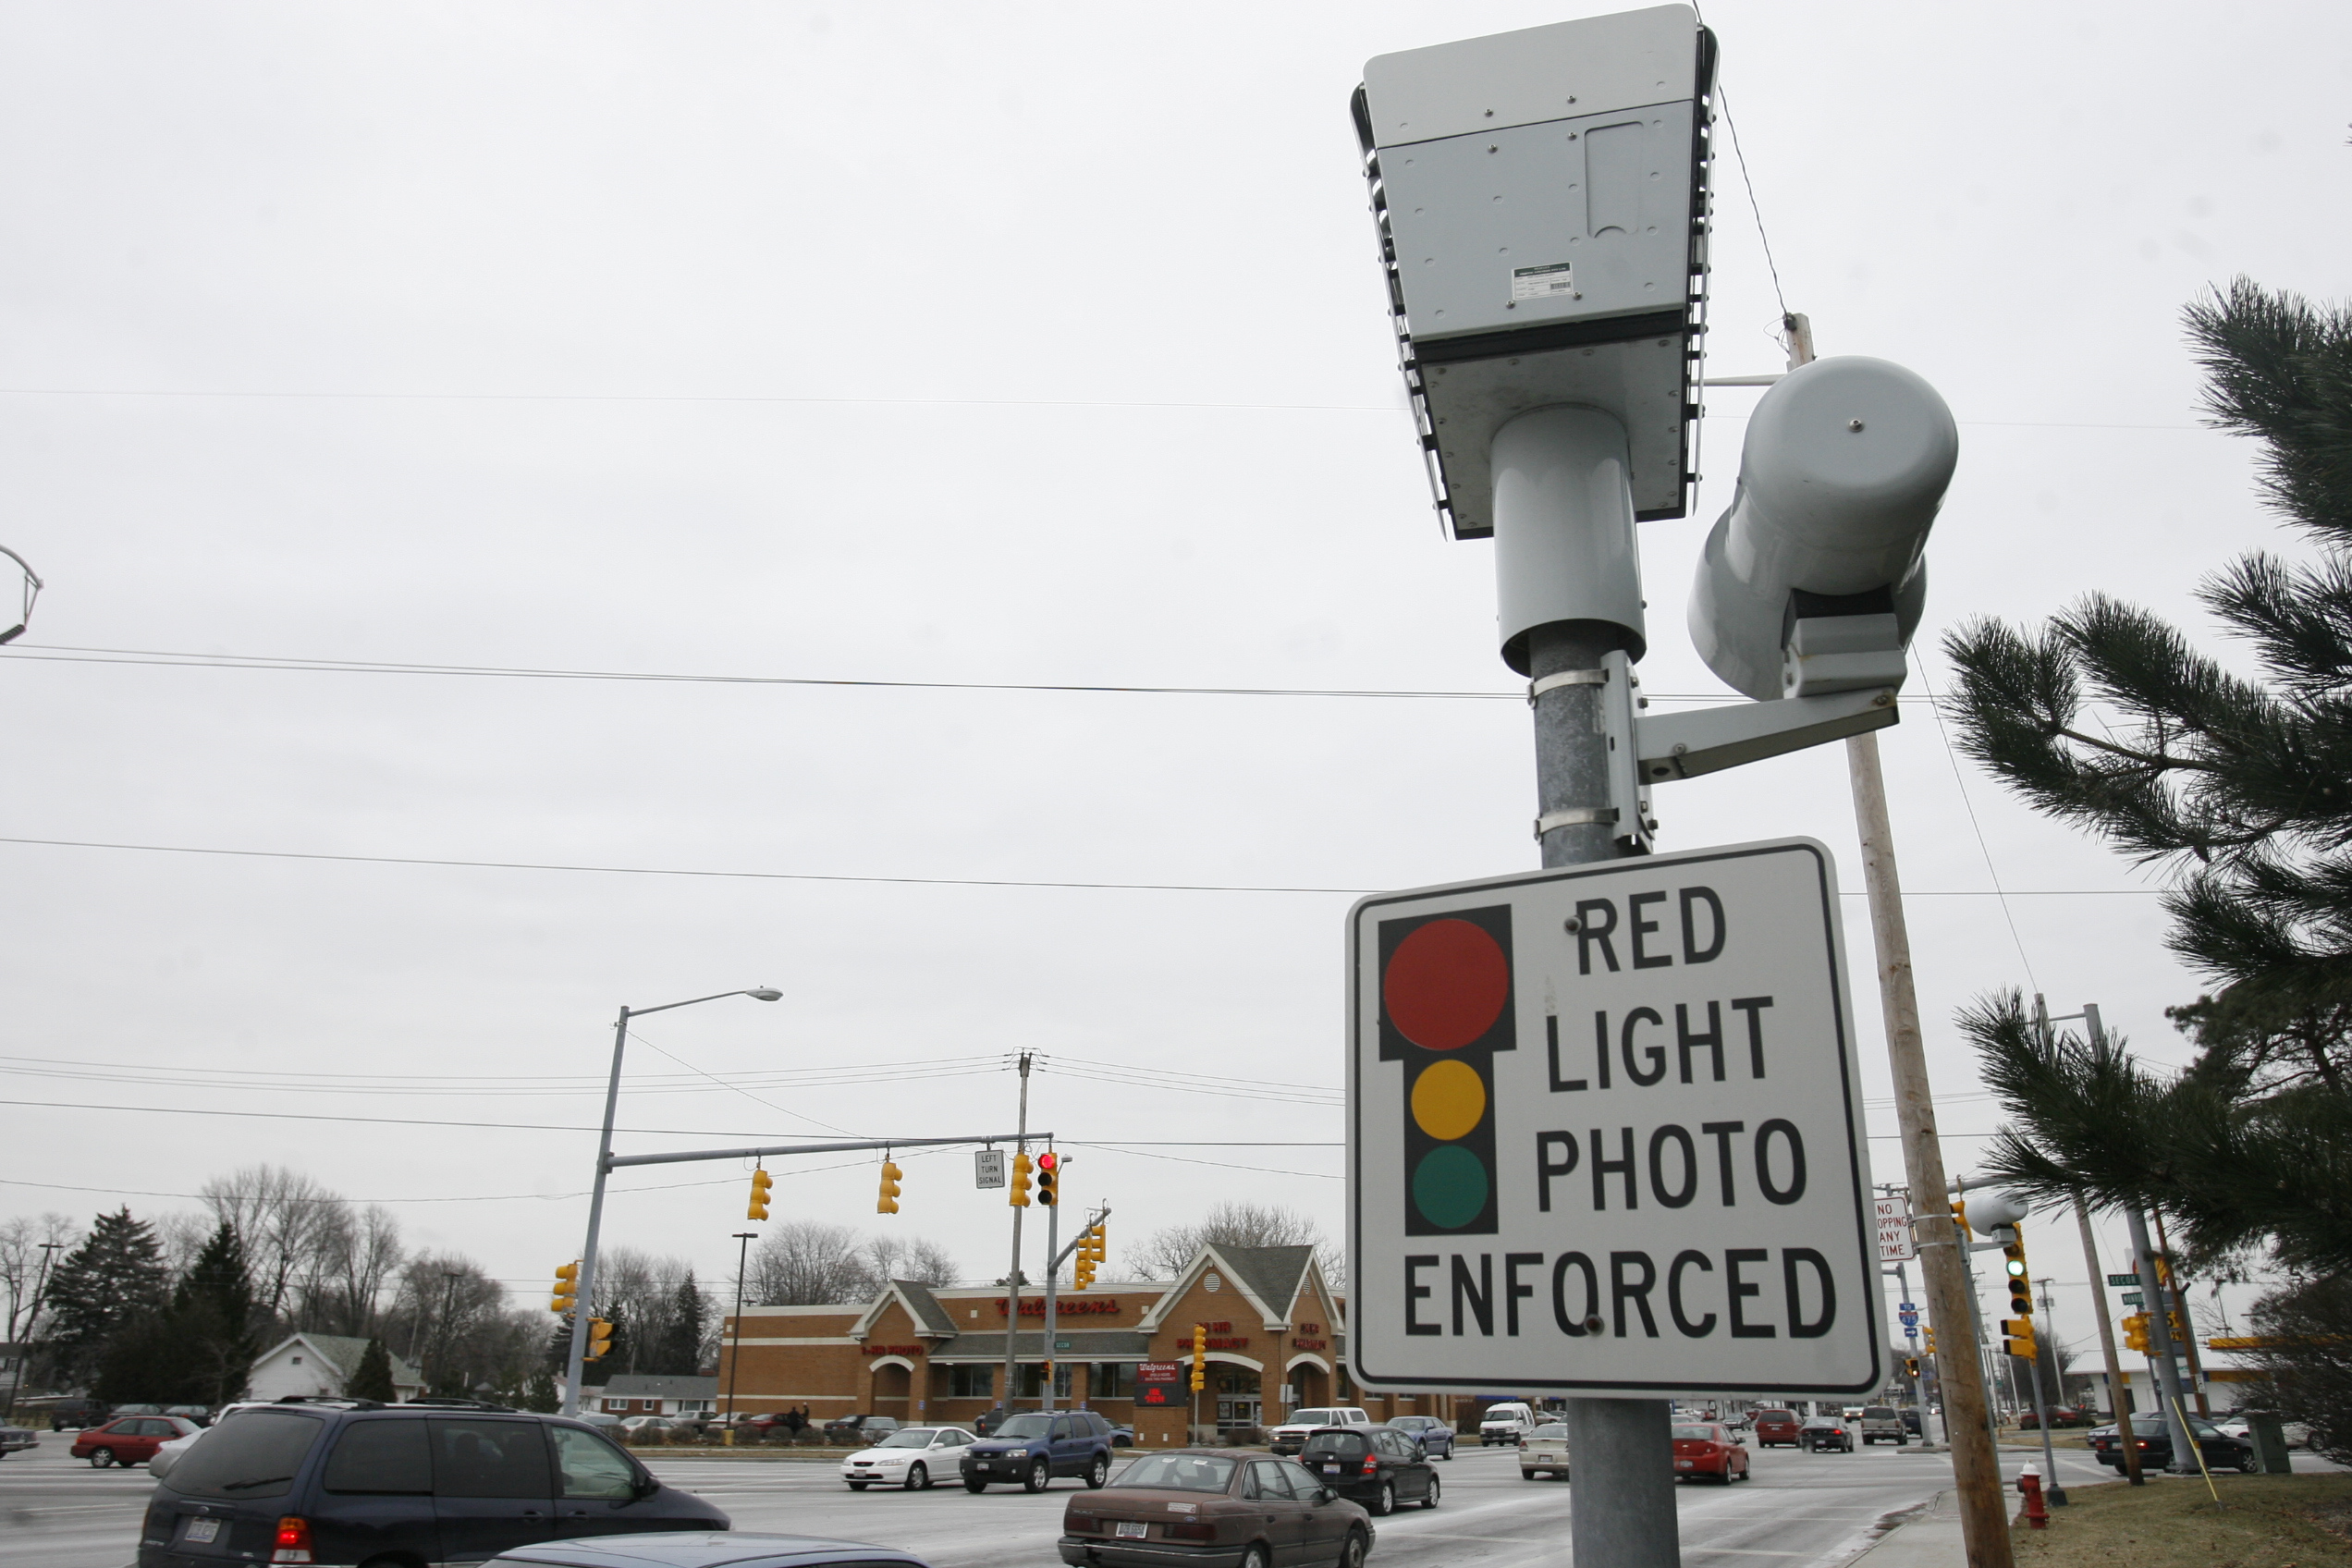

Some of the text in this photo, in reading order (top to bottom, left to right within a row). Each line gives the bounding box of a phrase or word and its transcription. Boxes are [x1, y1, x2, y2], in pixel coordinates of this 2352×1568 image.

[1575, 886, 1727, 975] RED
[1546, 996, 1774, 1093] LIGHT
[981, 1155, 997, 1163] LEFT
[981, 1165, 998, 1173] TURN
[1536, 1118, 1807, 1212] PHOTO
[978, 1176, 1002, 1184] SIGNAL
[1877, 1204, 1893, 1215] NO
[1877, 1217, 1907, 1229] OPPING
[1880, 1231, 1900, 1243] ANY
[1880, 1244, 1905, 1256] TIME
[2110, 1276, 2138, 1285] SECOR
[1404, 1247, 1837, 1339] ENFORCED
[2123, 1294, 2144, 1304] MONRO
[995, 1298, 1121, 1319] Walgreens
[1901, 1316, 1917, 1324] 475
[1213, 1321, 1231, 1332] HR
[1177, 1338, 1248, 1349] PHRMACY
[888, 1345, 924, 1355] PHOTO
[1139, 1363, 1176, 1373] Walgreens
